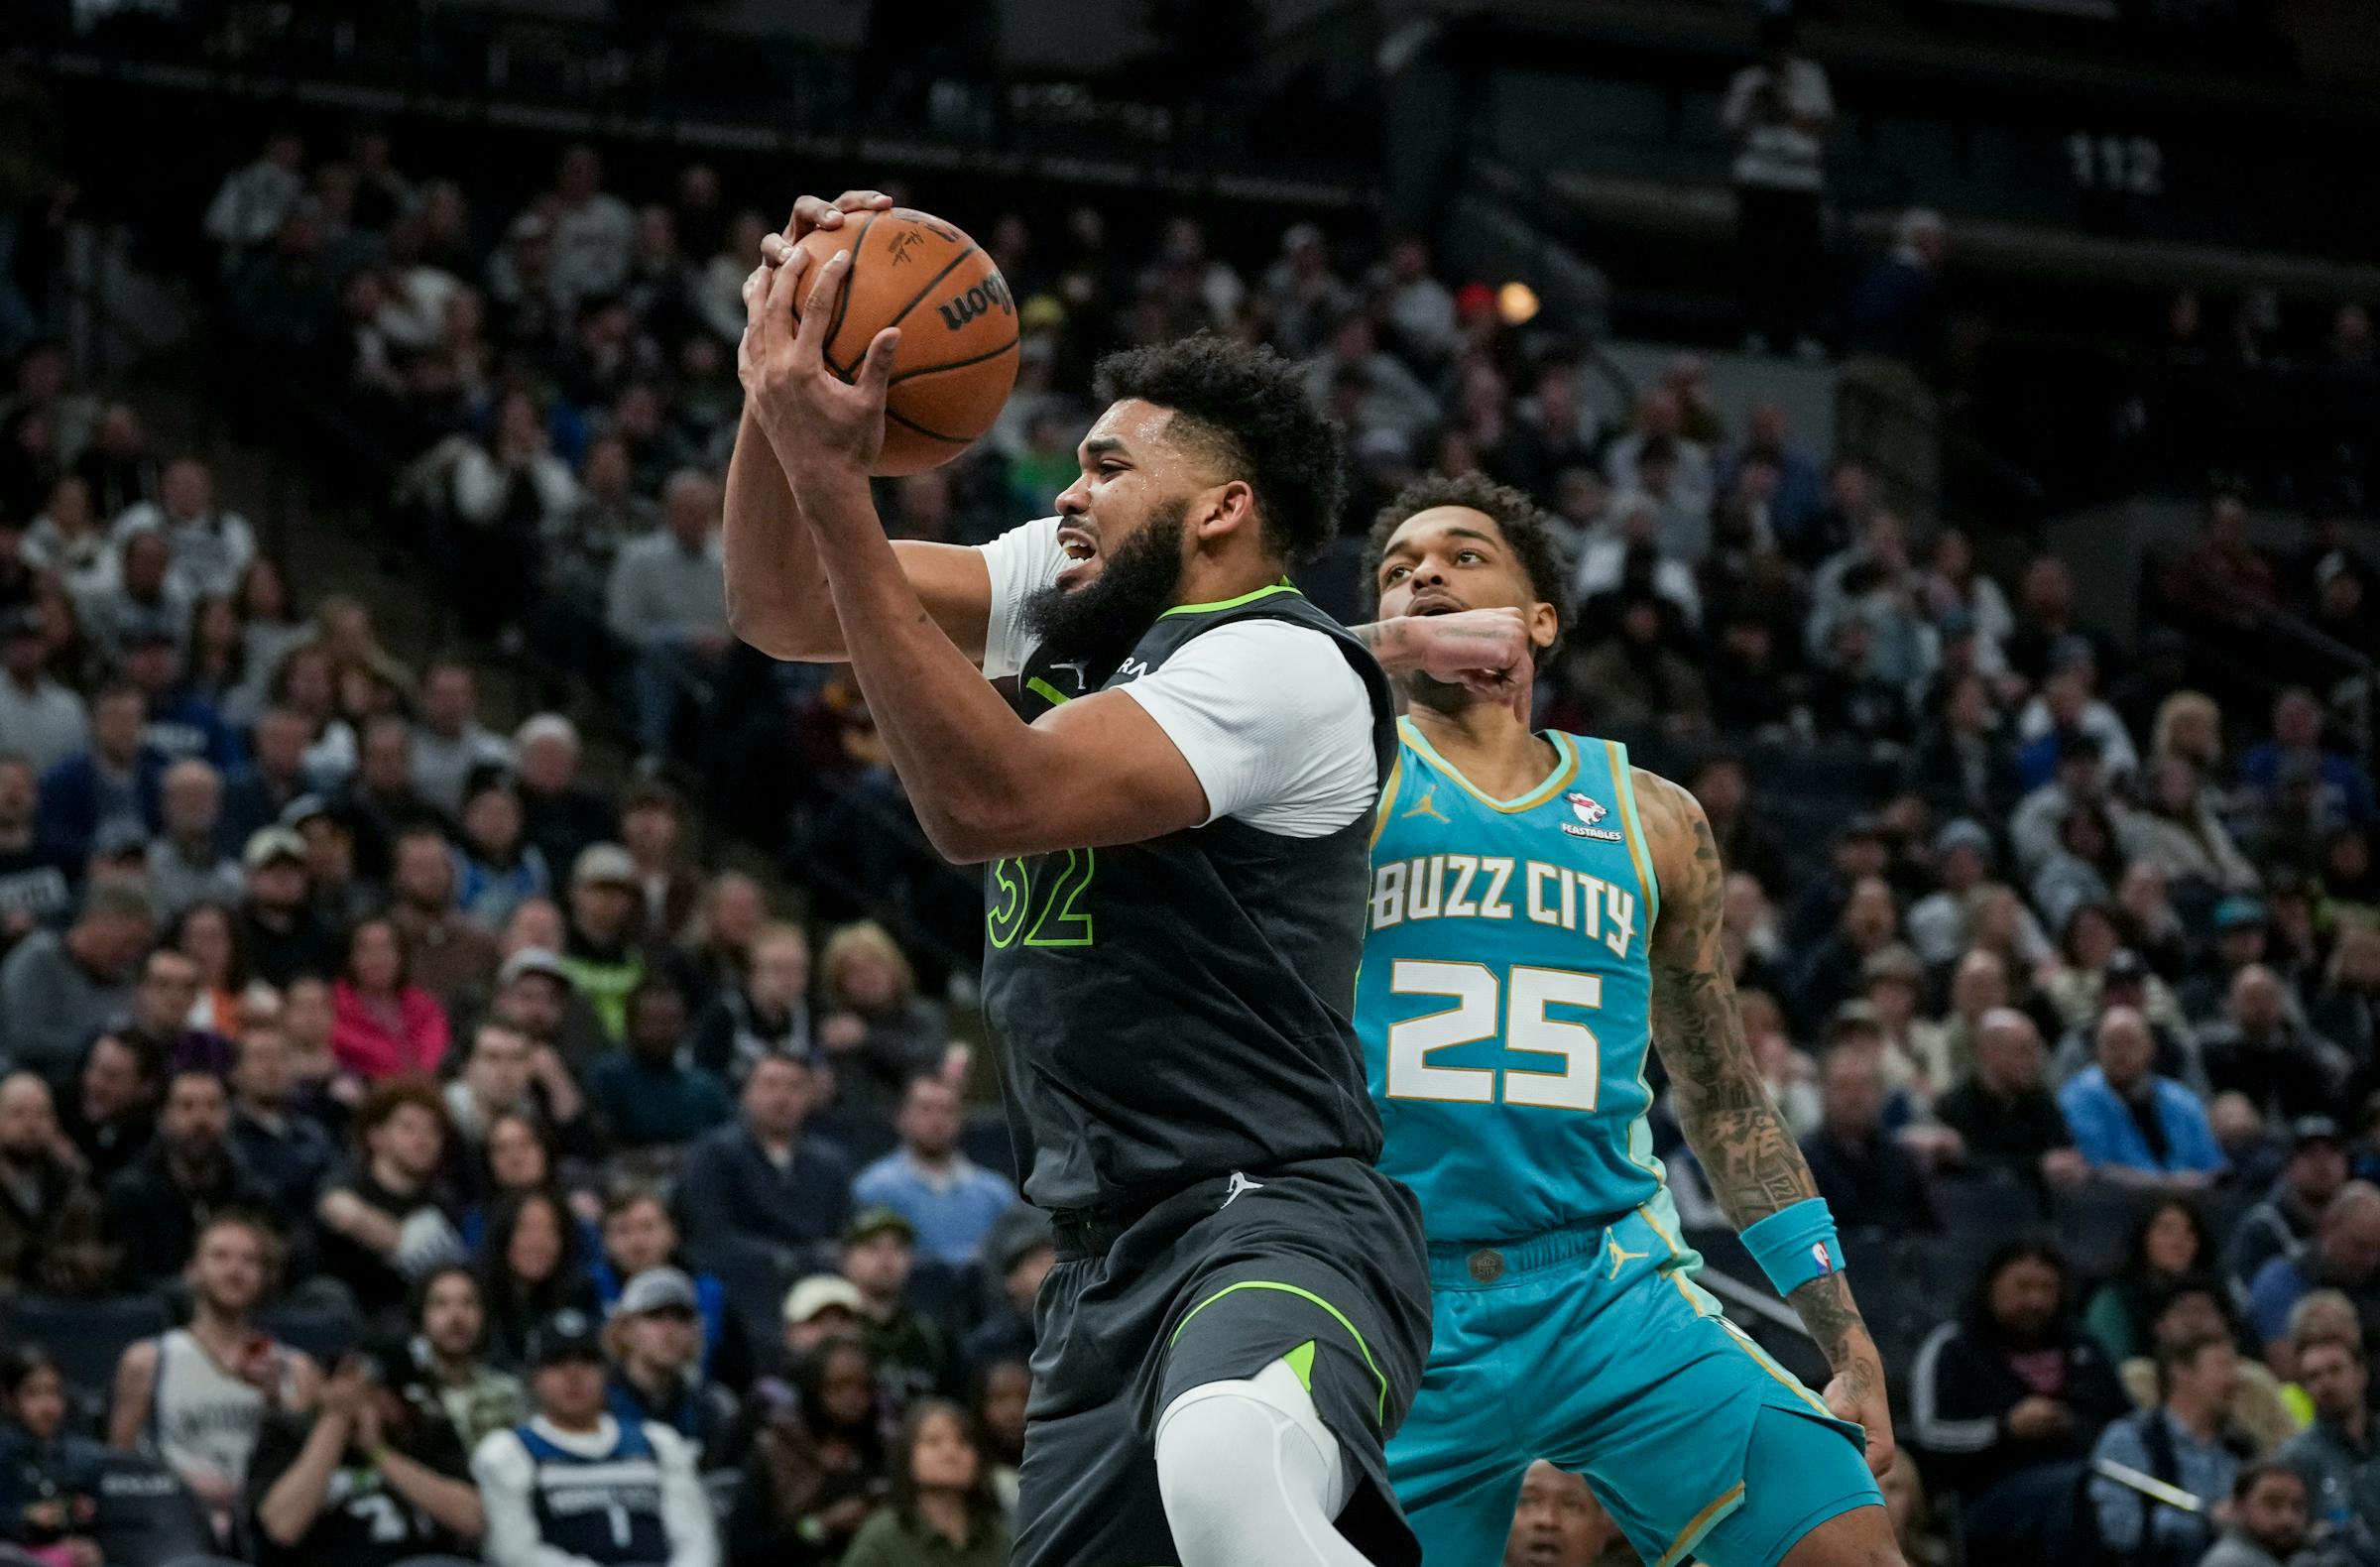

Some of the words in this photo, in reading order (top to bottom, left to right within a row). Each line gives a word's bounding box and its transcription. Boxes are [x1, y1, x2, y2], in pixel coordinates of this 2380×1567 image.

[2069, 133, 2163, 192] 112
[1562, 822, 1622, 841] FEASTABLES
[988, 847, 1094, 948] 32
[1368, 854, 1514, 930] BUZZ
[1526, 860, 1636, 959] CITY
[1386, 958, 1603, 1113] 25
